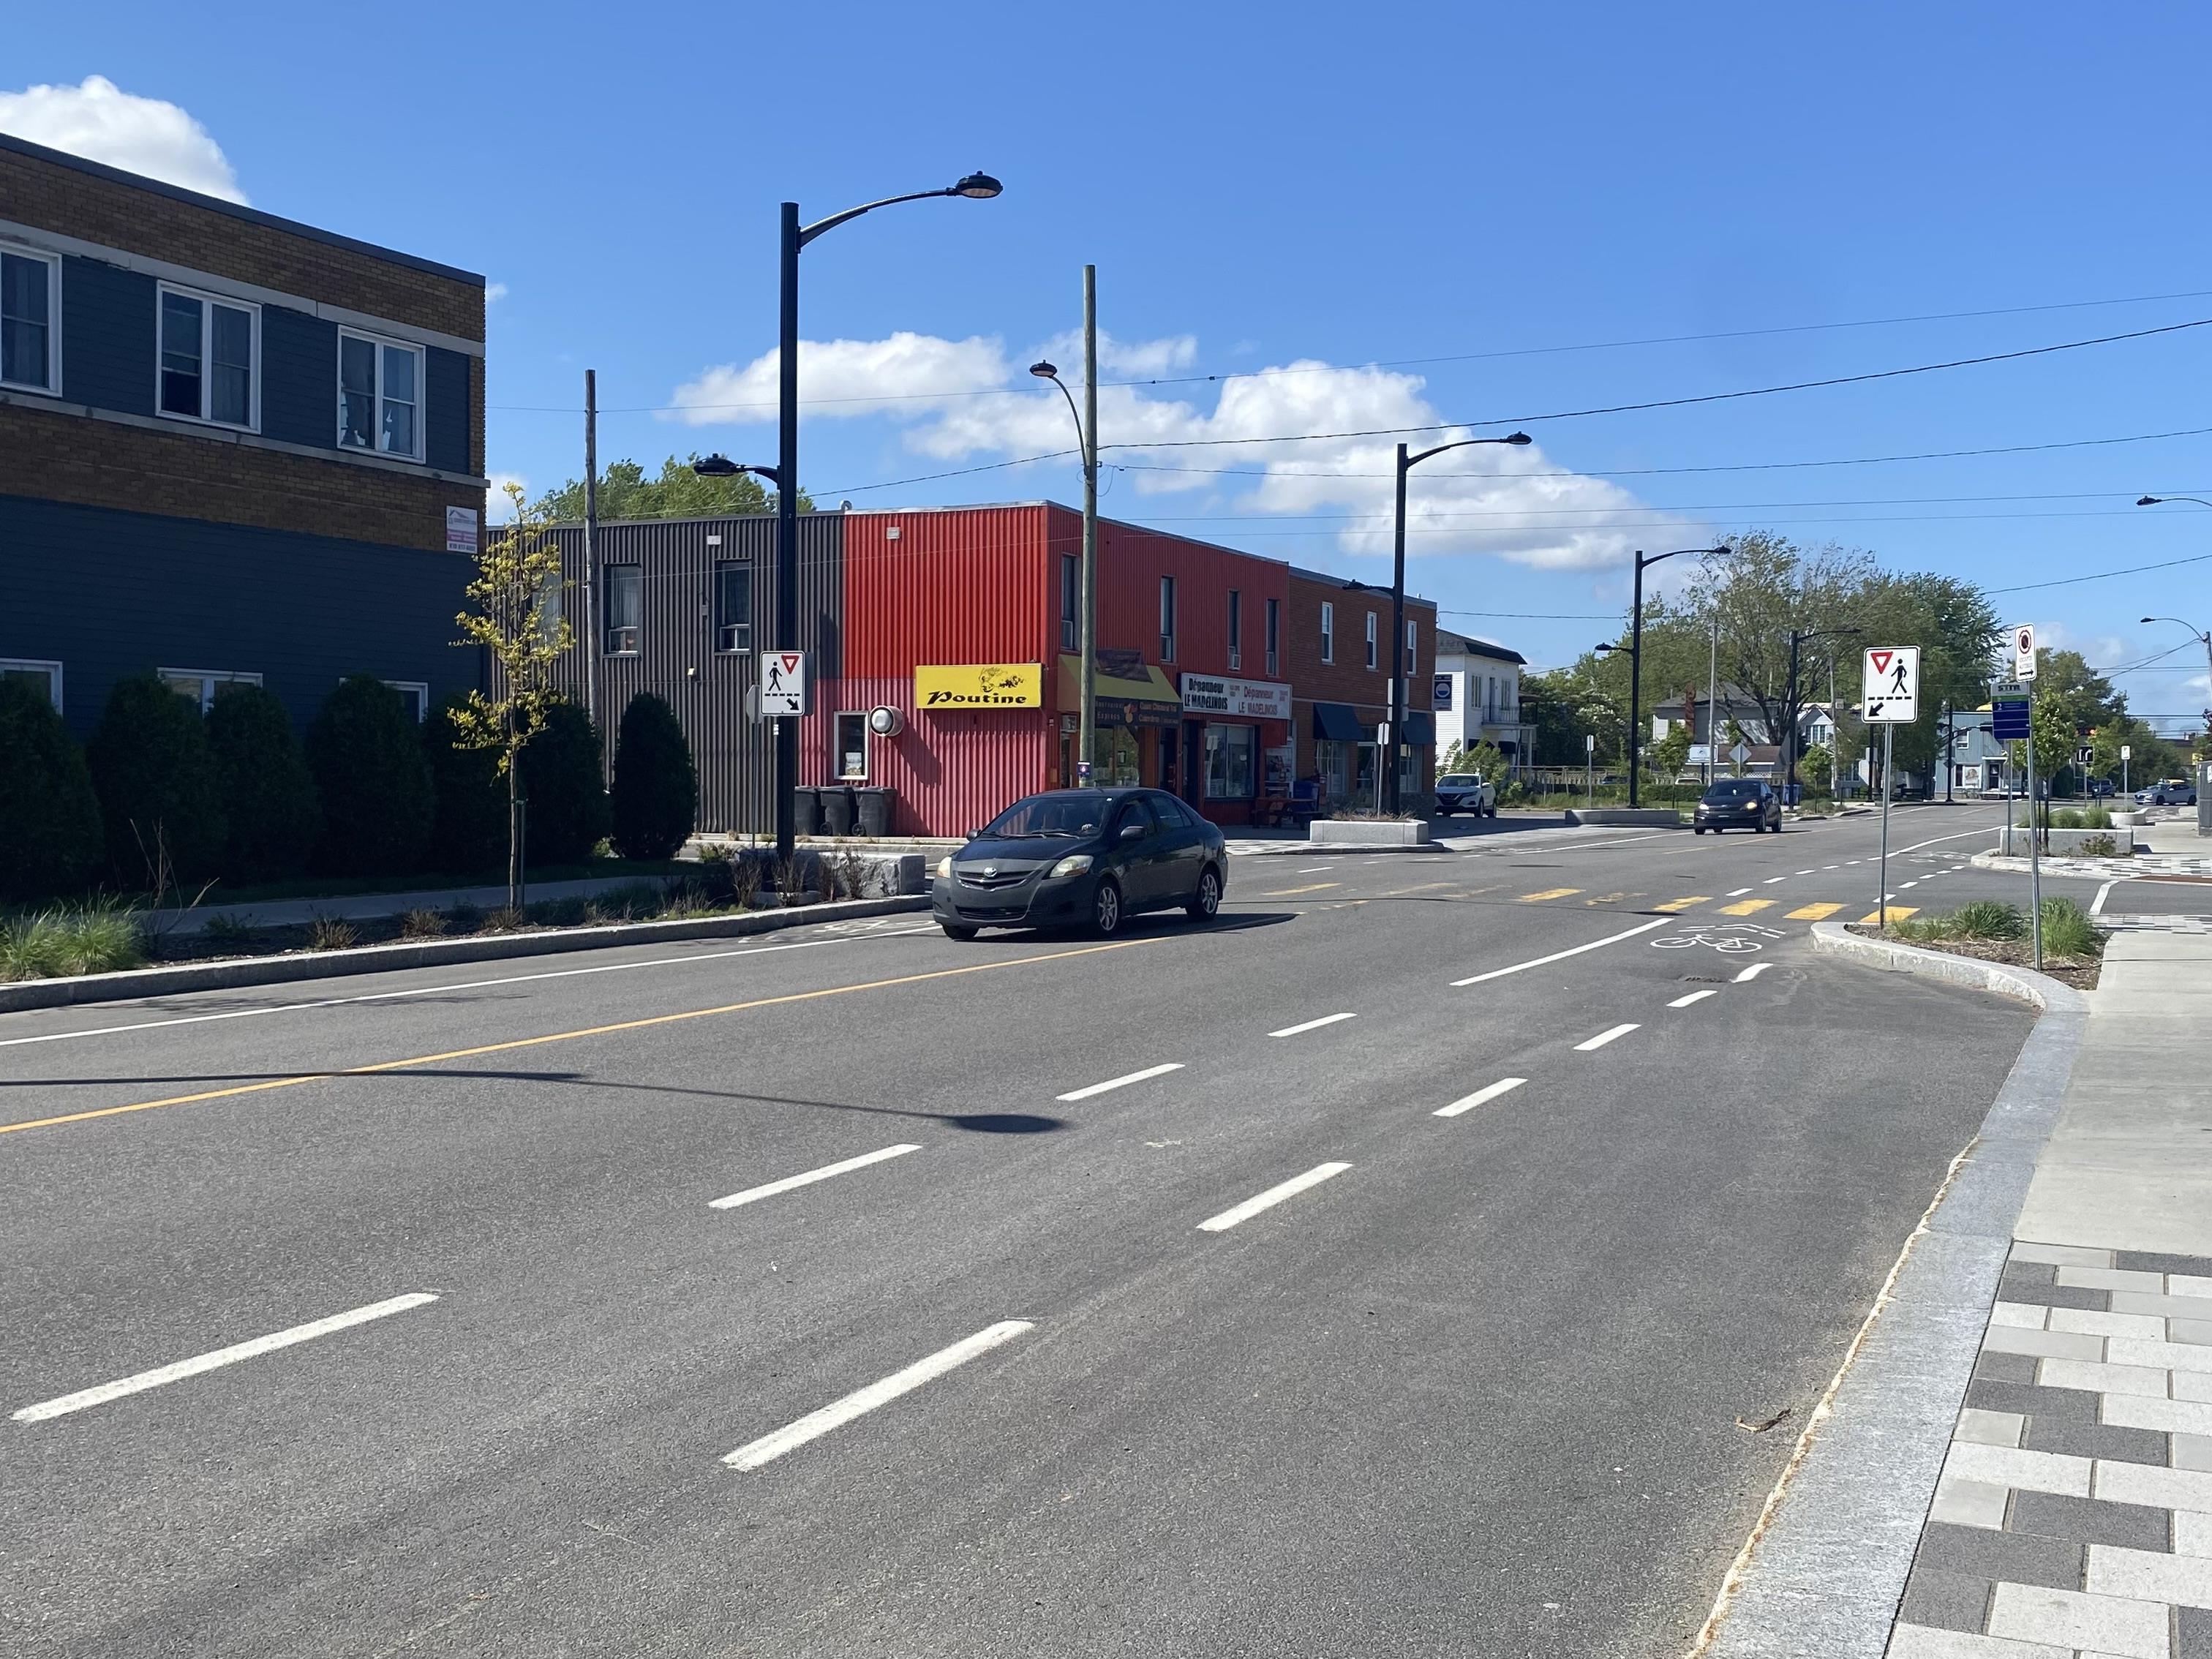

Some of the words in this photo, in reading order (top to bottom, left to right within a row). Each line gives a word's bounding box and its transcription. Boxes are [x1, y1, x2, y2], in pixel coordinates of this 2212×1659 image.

[927, 691, 1027, 705] Poutine
[1184, 693, 1190, 707] LE
[1192, 694, 1228, 710] MADELINOIS
[1238, 701, 1245, 713] LE
[1247, 702, 1277, 715] MADELINOIS
